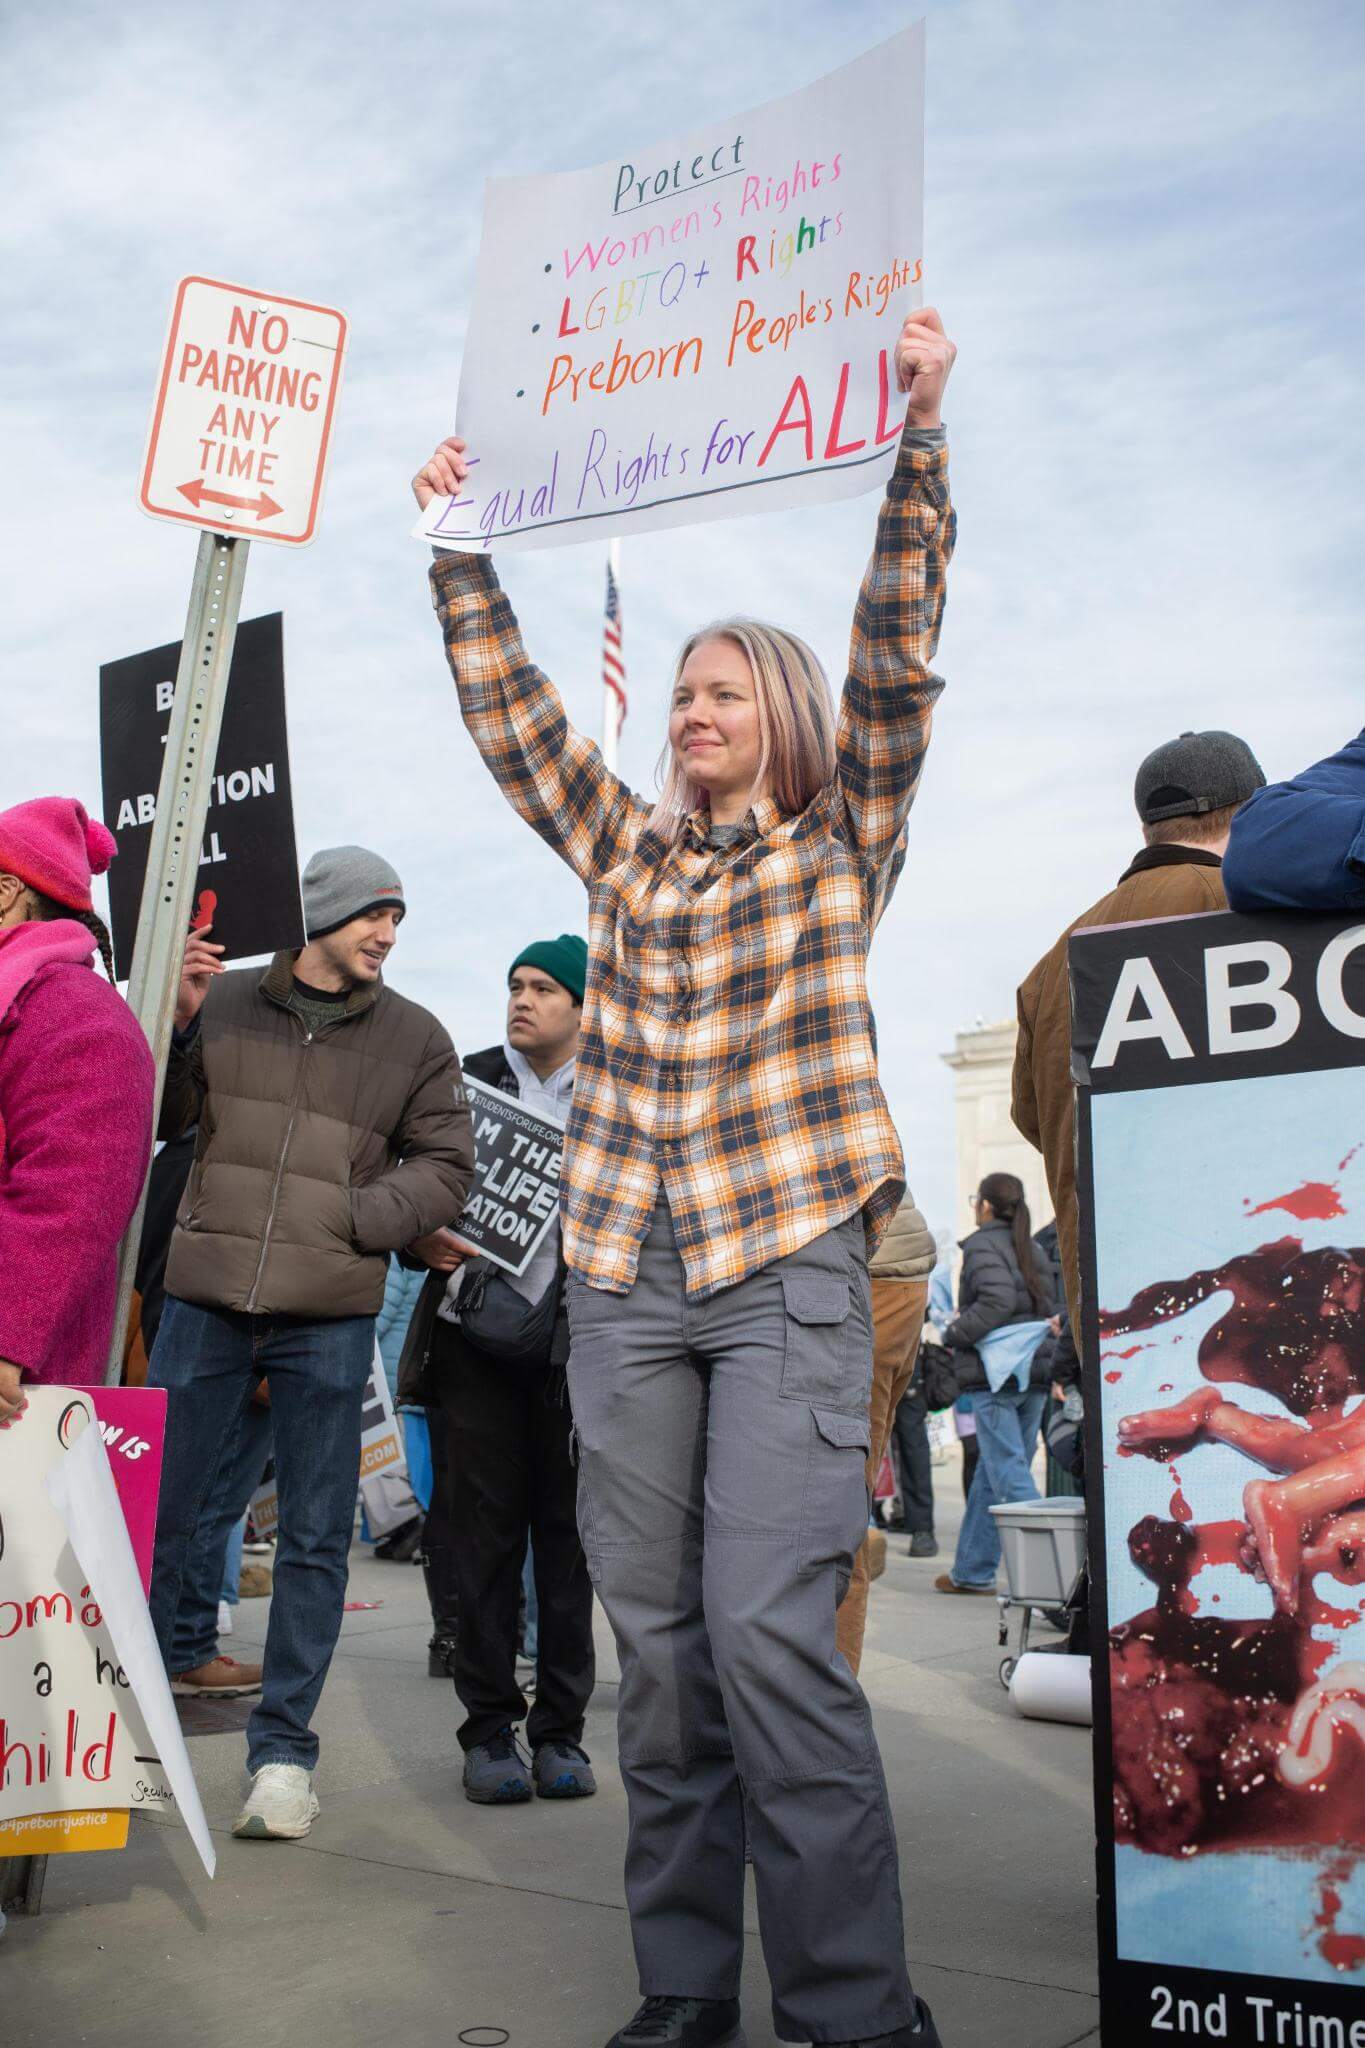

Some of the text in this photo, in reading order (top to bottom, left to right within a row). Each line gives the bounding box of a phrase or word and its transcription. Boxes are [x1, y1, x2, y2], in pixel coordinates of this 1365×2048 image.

[614, 136, 743, 212] Protect
[564, 153, 842, 280] Women's Rights
[558, 212, 842, 338] LGBTQ+ Rights
[227, 306, 289, 354] NO
[542, 258, 922, 416] Preborn People's Rights
[178, 343, 322, 412] PARKING
[206, 403, 281, 445] ANY
[433, 349, 905, 548] Equal Rights for ALL
[199, 438, 279, 485] TIME
[510, 1132, 562, 1180] THE
[118, 1436, 150, 1460] IS
[33, 1661, 52, 1697] a
[1150, 1986, 1228, 2037] 2nd
